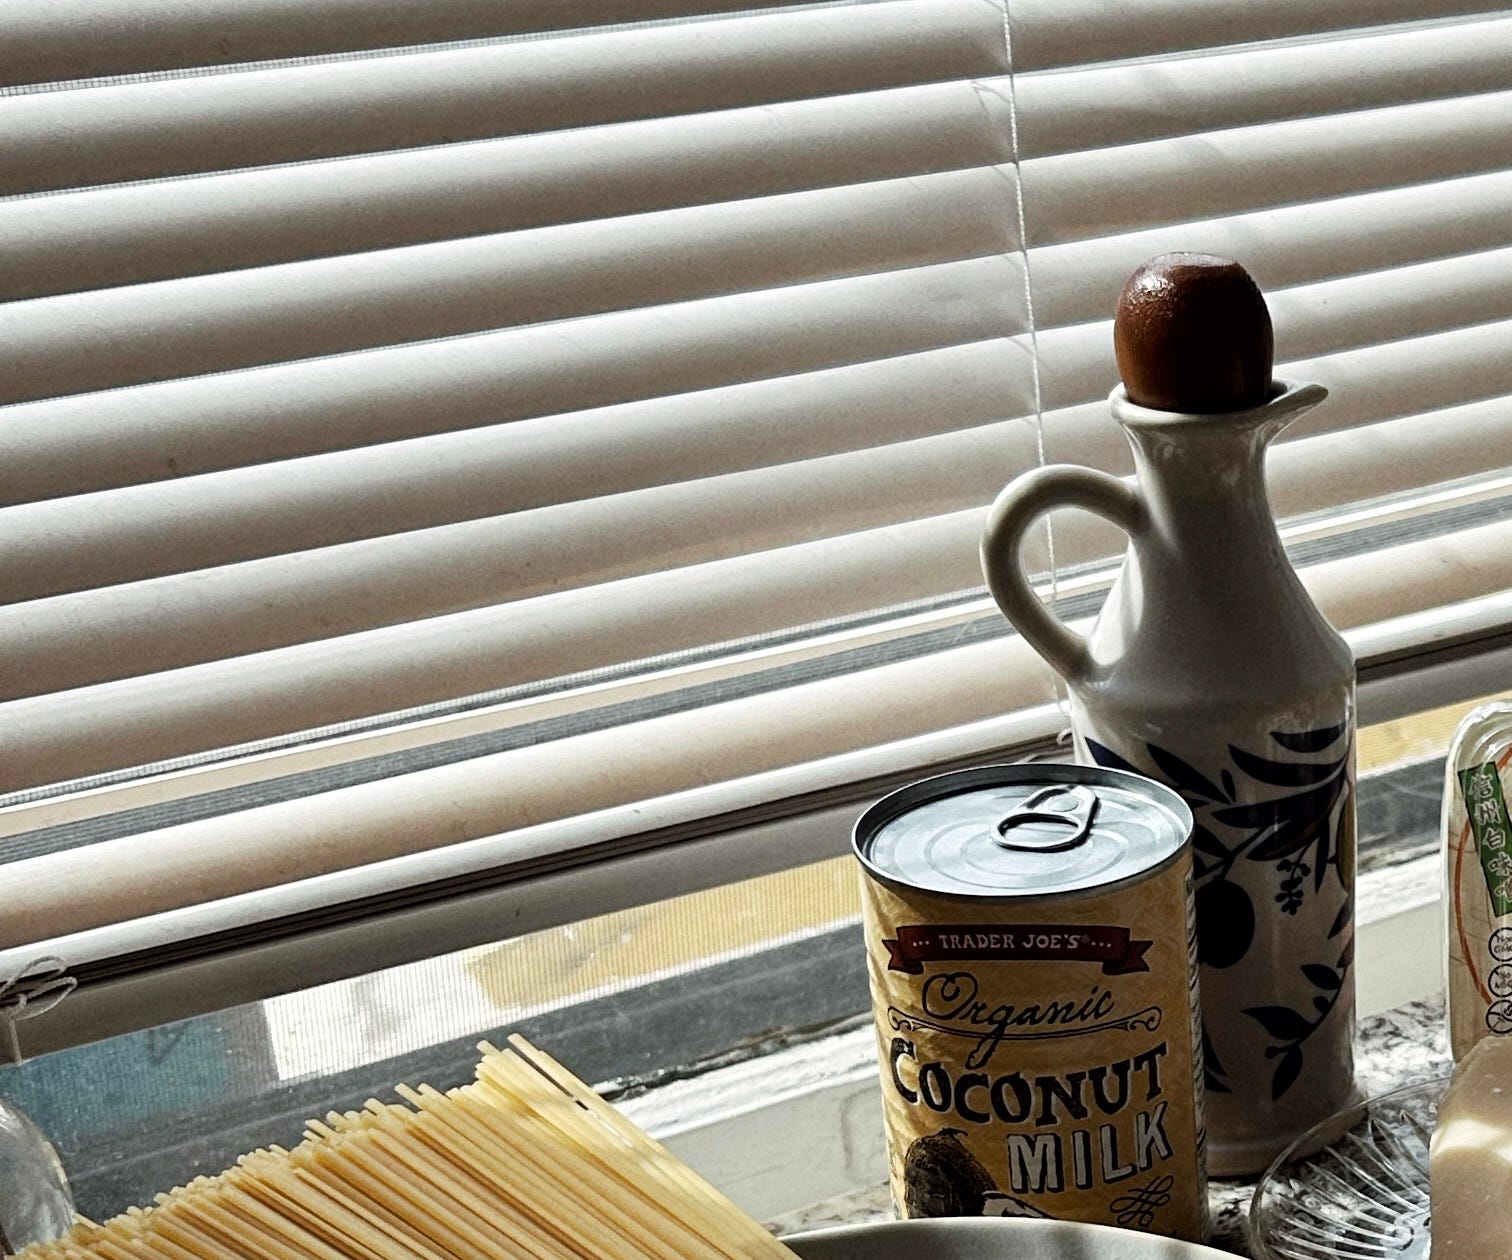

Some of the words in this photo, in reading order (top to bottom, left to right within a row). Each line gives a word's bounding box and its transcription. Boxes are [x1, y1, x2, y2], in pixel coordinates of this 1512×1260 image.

[939, 934, 1015, 949] TRADER
[1021, 934, 1081, 949] JOE'S
[922, 972, 1115, 1070] Organic
[890, 1037, 1167, 1127] COCONUT
[1006, 1101, 1174, 1193] MILK
